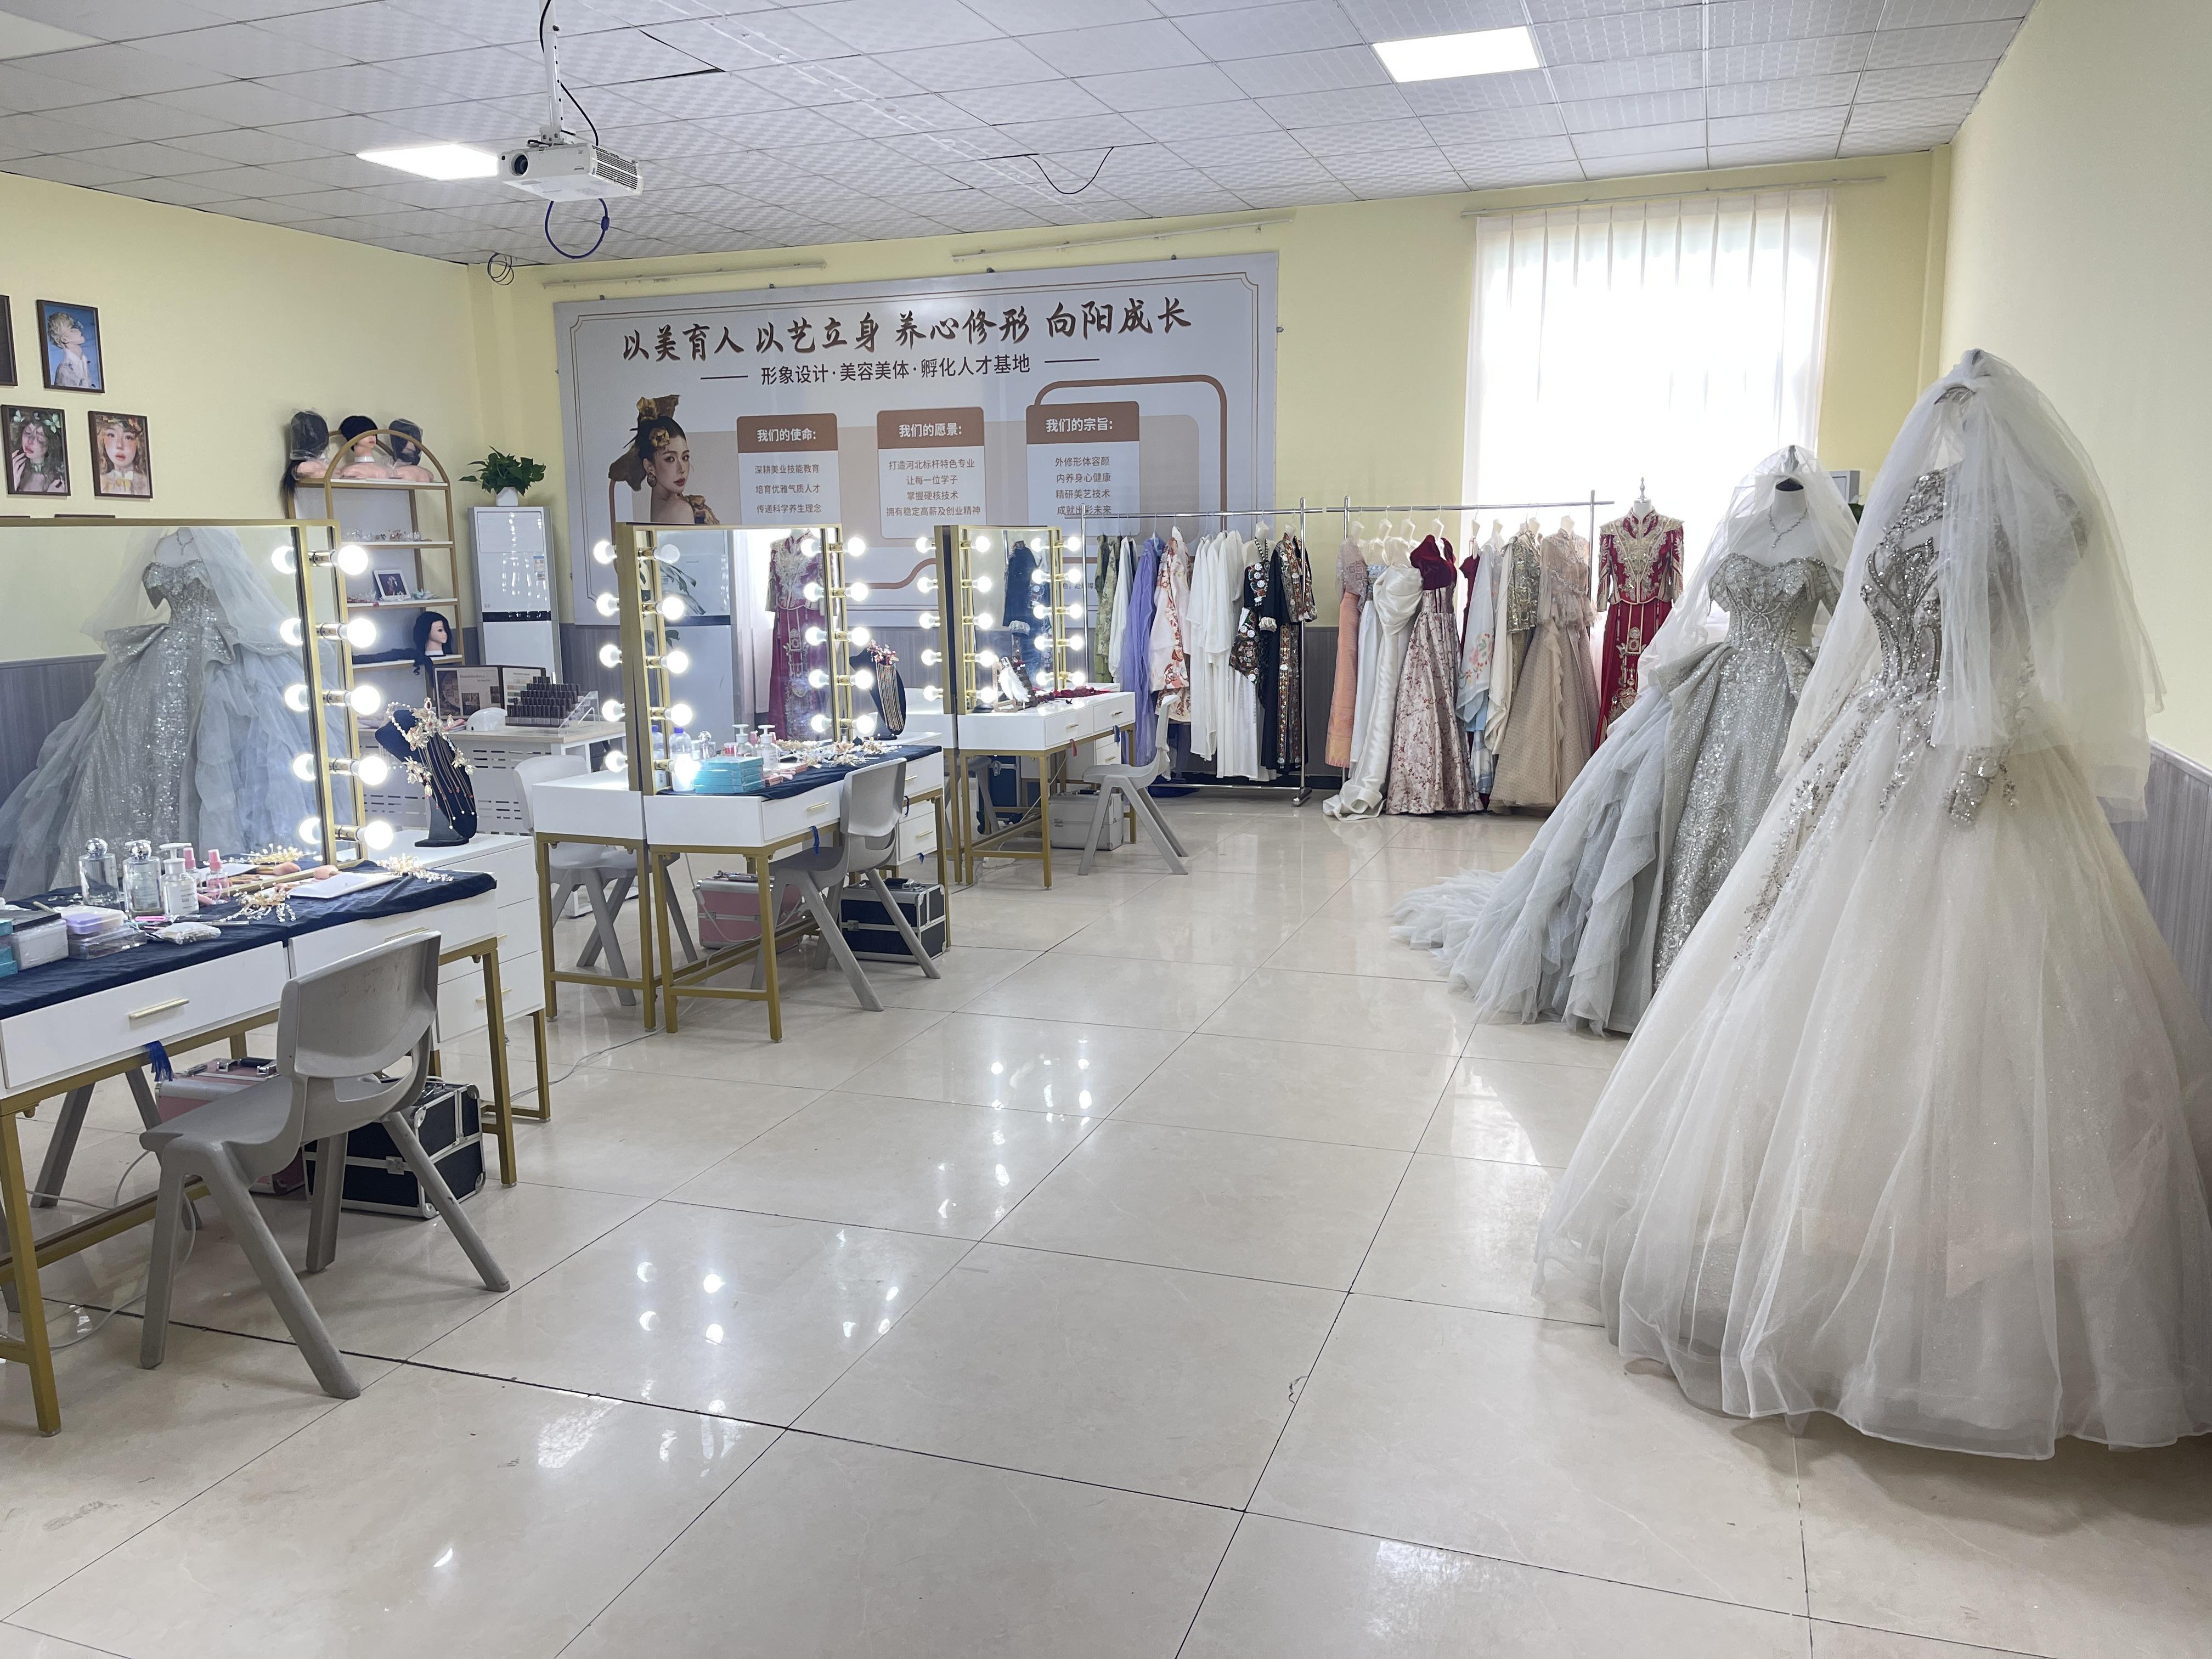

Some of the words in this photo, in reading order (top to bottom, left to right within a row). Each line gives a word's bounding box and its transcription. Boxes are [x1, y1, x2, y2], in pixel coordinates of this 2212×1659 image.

[623, 323, 744, 362] 以美育人
[756, 312, 879, 354] 以艺立身
[895, 305, 1030, 350] 养心修形
[1046, 297, 1192, 340] 向阳成长
[761, 354, 1030, 385] 形象设计·美容美体·孵化人才基地
[1046, 417, 1113, 432] 我们的宗旨：
[757, 428, 816, 442] 我们的使命：
[889, 458, 975, 470] 打造河北标杆特色专业
[1054, 456, 1110, 467] 外修形体容颜
[755, 464, 820, 475] 深耕美业技能教育
[906, 475, 958, 486] 让每一位学子
[1056, 472, 1111, 483] 内养身心健康
[755, 484, 821, 494] 培育优雅气质人才
[1056, 489, 1110, 499] 精研美艺技术
[907, 490, 958, 501] 掌握硬核技术
[757, 504, 822, 514] 传递科学养生理念
[886, 505, 980, 517] 拥有稳定高薪及创业精神
